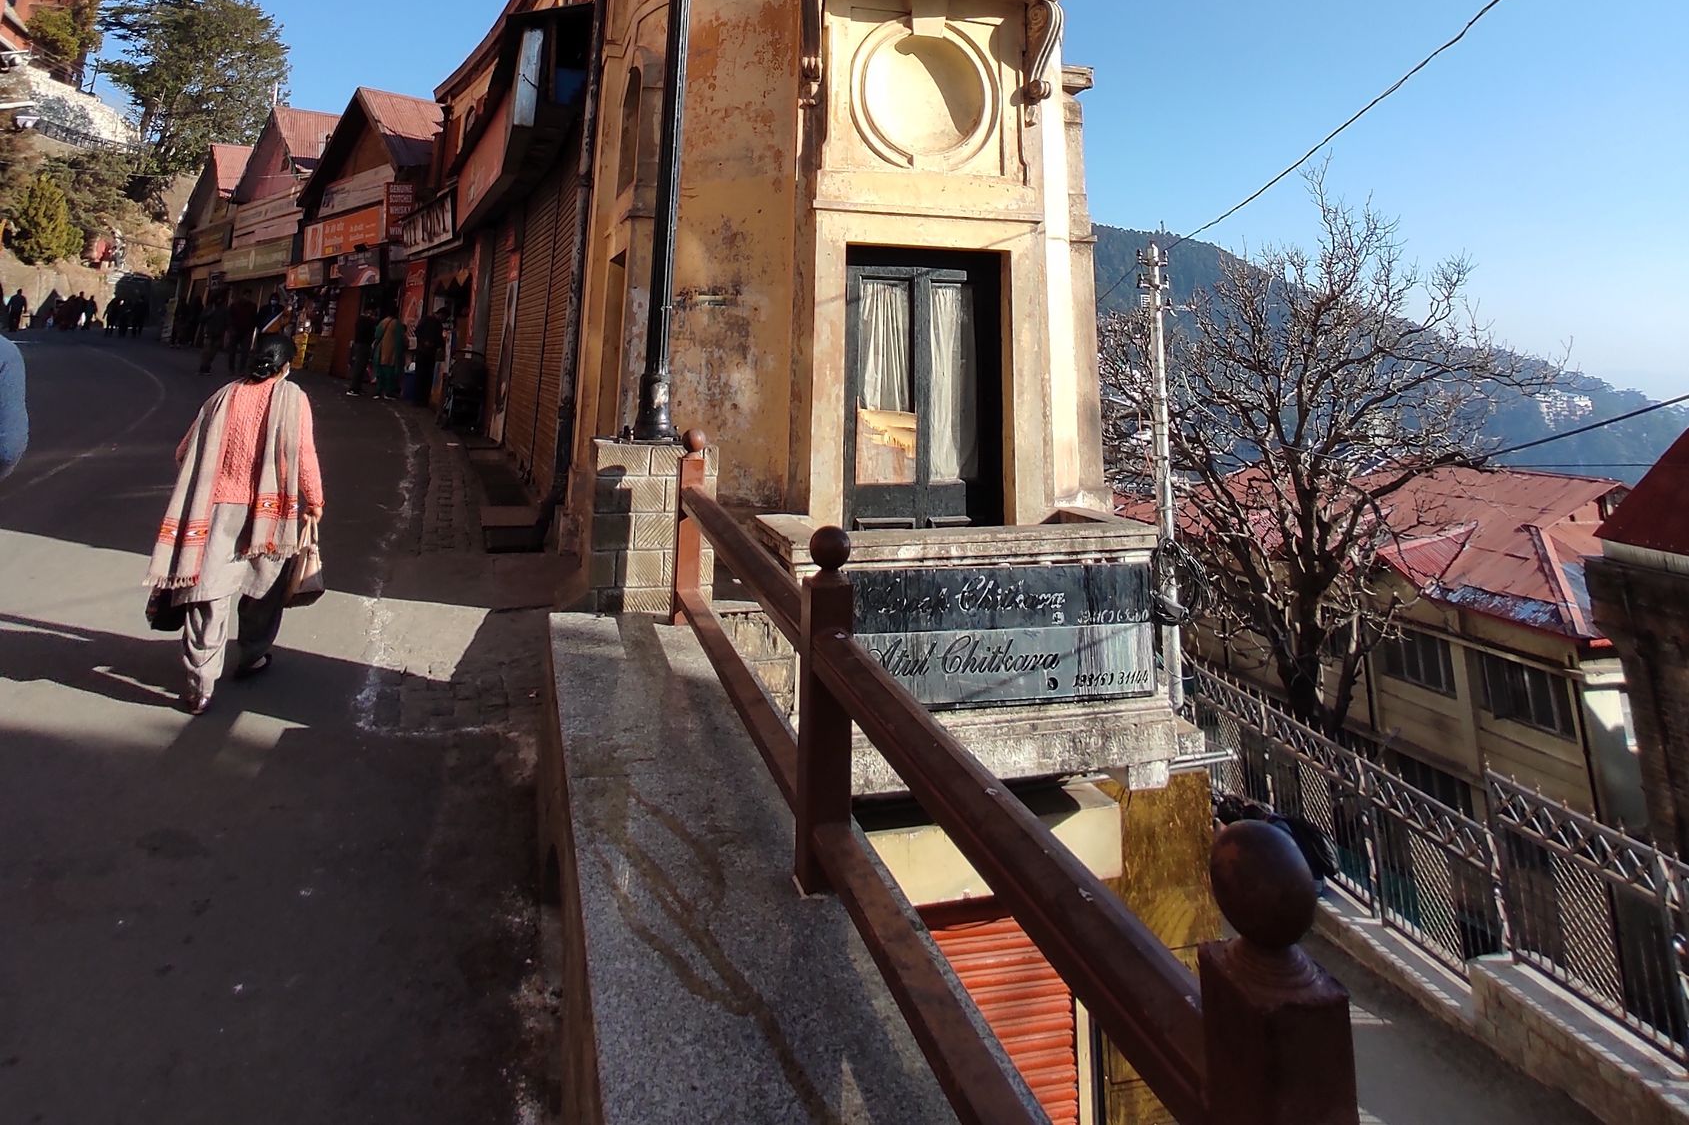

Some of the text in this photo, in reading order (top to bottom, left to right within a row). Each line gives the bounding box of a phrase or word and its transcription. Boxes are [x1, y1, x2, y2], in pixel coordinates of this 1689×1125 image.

[389, 184, 413, 193] GENUINE
[389, 226, 403, 235] WIN
[869, 635, 1060, 677] Atul Chitkara
[1118, 670, 1149, 685] 31144
